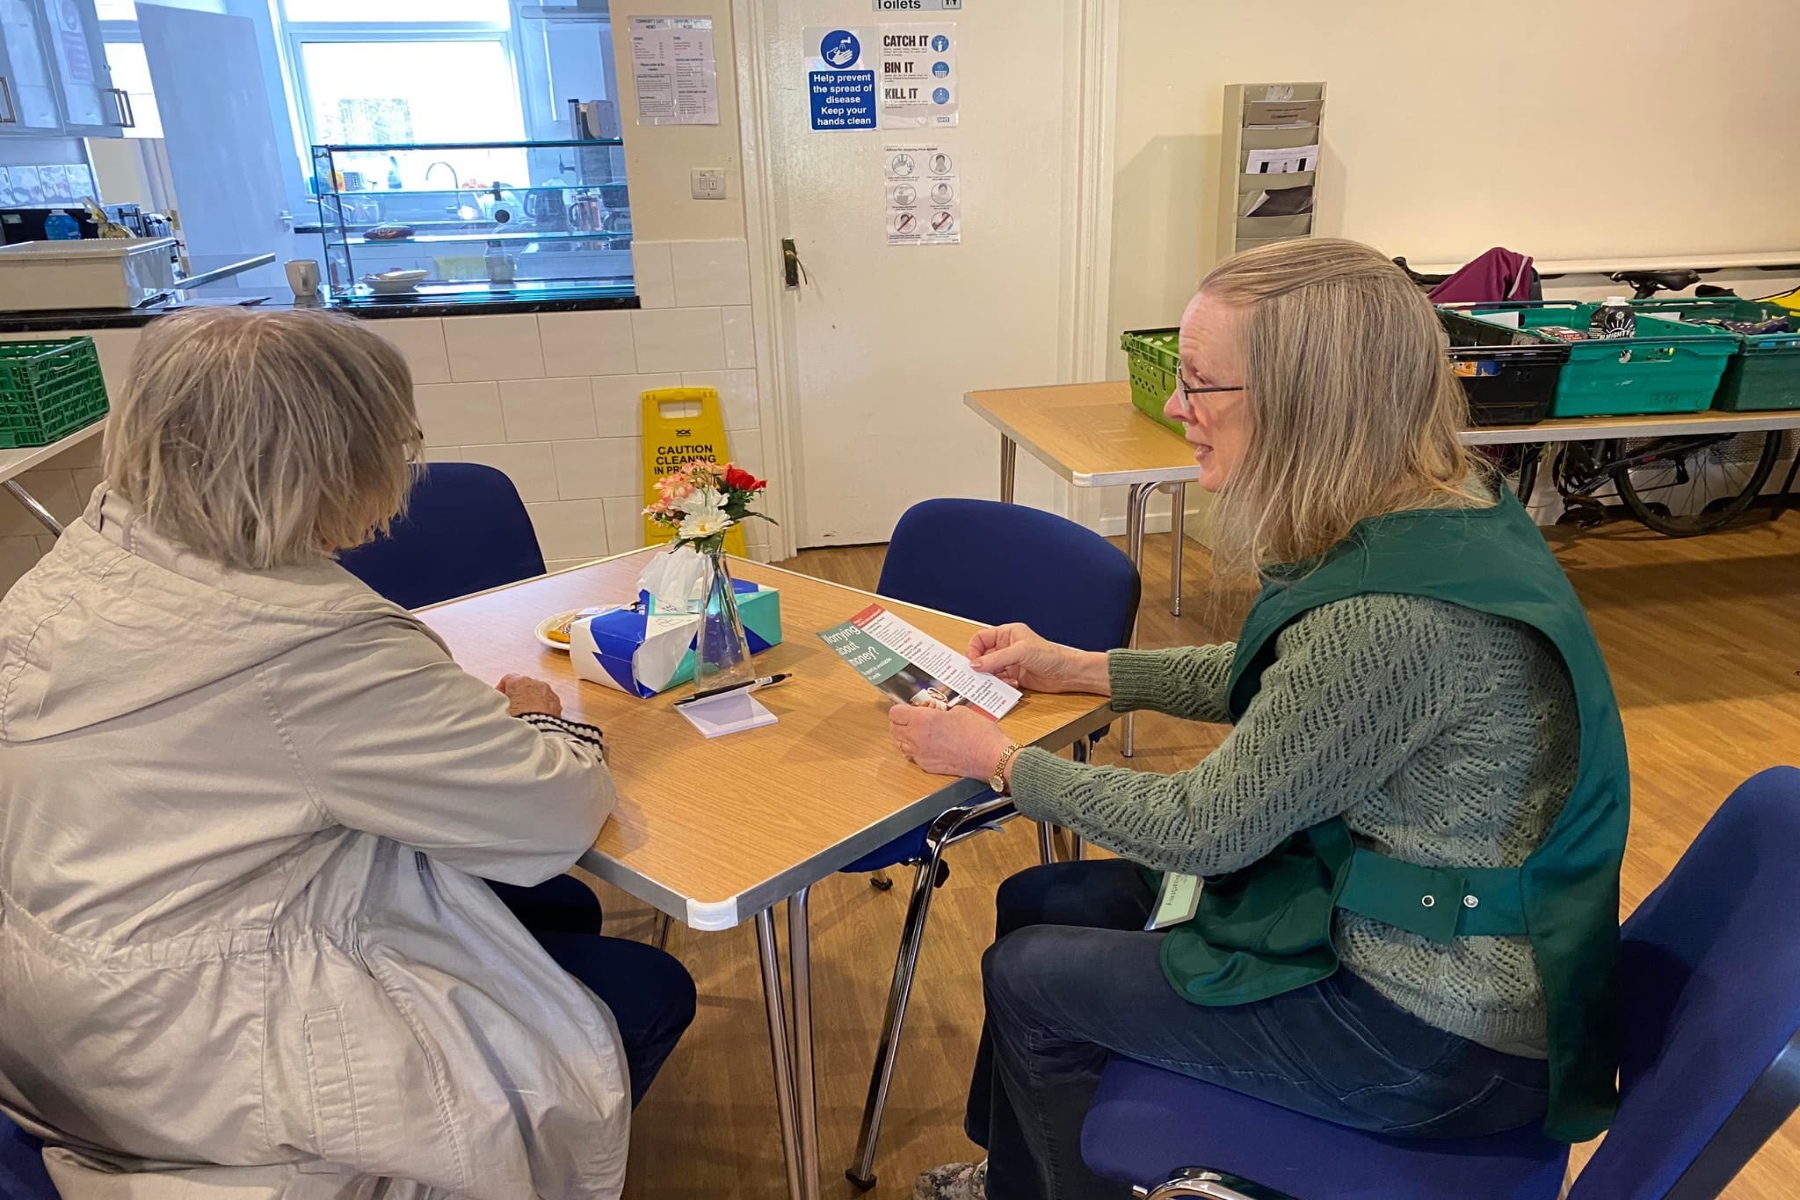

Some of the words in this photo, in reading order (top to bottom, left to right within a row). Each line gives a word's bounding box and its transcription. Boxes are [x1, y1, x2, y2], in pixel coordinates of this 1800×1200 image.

[878, 0, 921, 9] Toilets
[883, 35, 916, 47] CATCH
[919, 35, 929, 47] IT
[884, 62, 901, 73] BIN
[904, 62, 914, 73] IT
[813, 74, 835, 84] Help
[837, 73, 871, 83] prevent
[813, 85, 828, 93] the
[830, 84, 861, 94] spread
[863, 84, 872, 92] of
[885, 88, 906, 99] KILL
[909, 88, 918, 99] IT
[825, 95, 861, 104] disease
[821, 106, 845, 116] Keep
[846, 107, 867, 116] your
[817, 117, 845, 126] hands
[847, 116, 872, 125] clean
[657, 444, 713, 455] CAUTION
[654, 466, 664, 475] IN
